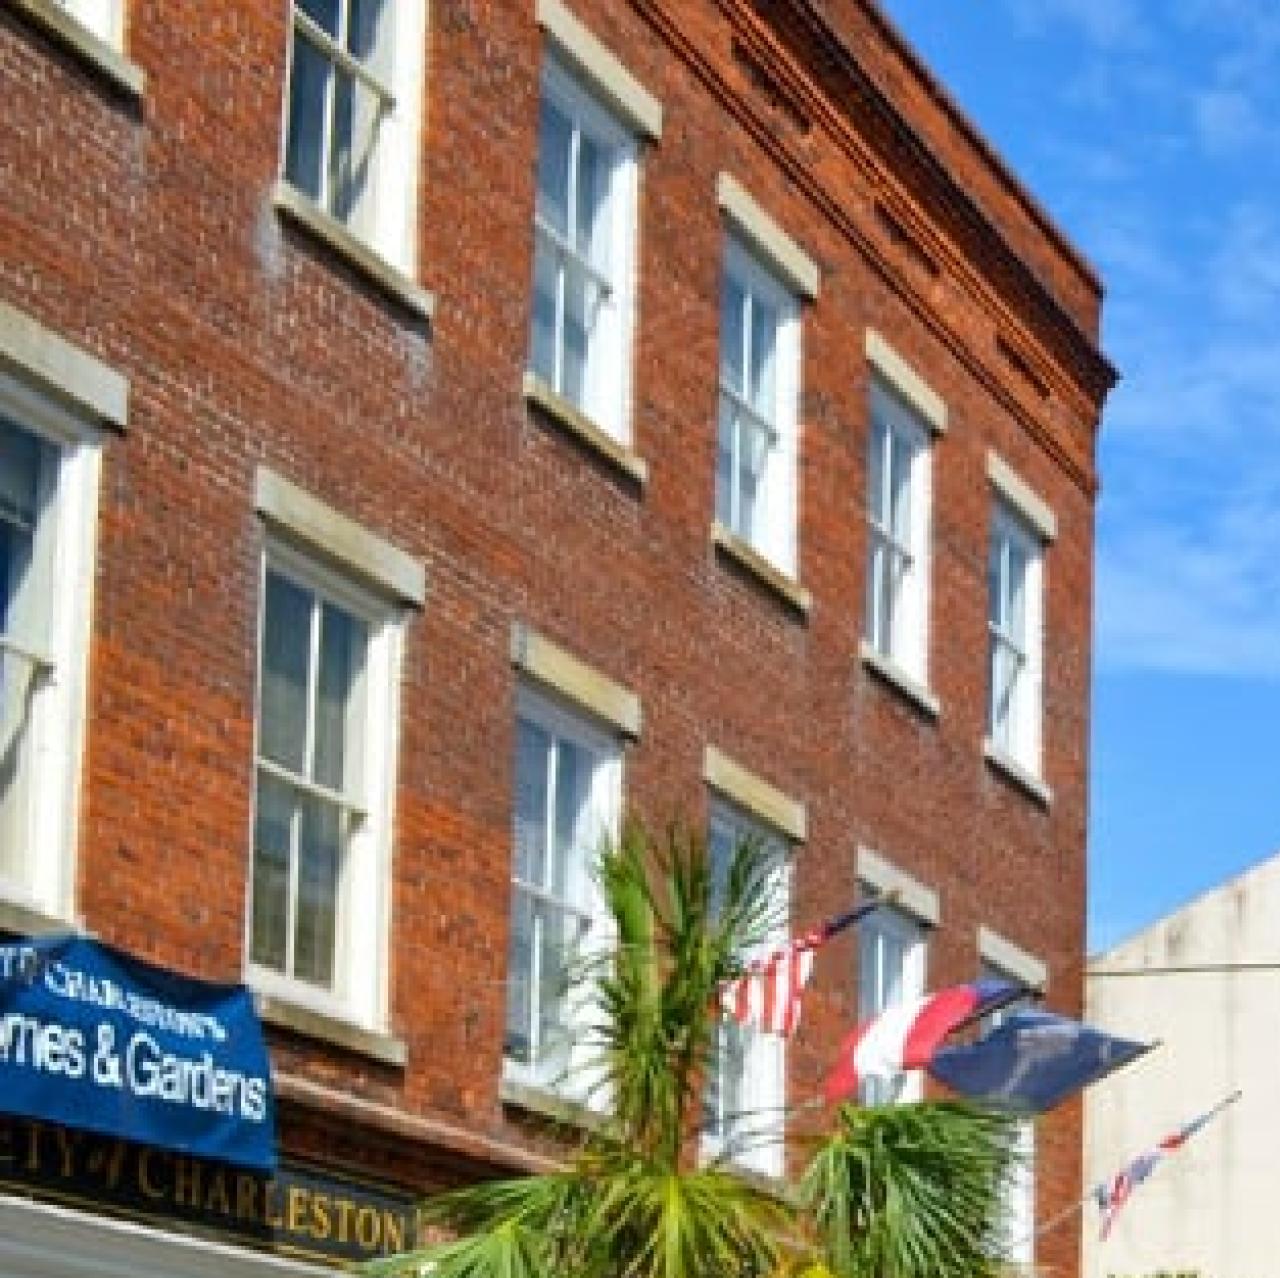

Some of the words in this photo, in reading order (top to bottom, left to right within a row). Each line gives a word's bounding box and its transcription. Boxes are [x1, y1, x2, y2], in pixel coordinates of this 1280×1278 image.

[92, 1022, 122, 1087] &
[126, 1031, 268, 1122] Gardens
[137, 1149, 405, 1254] CHARLESTON
